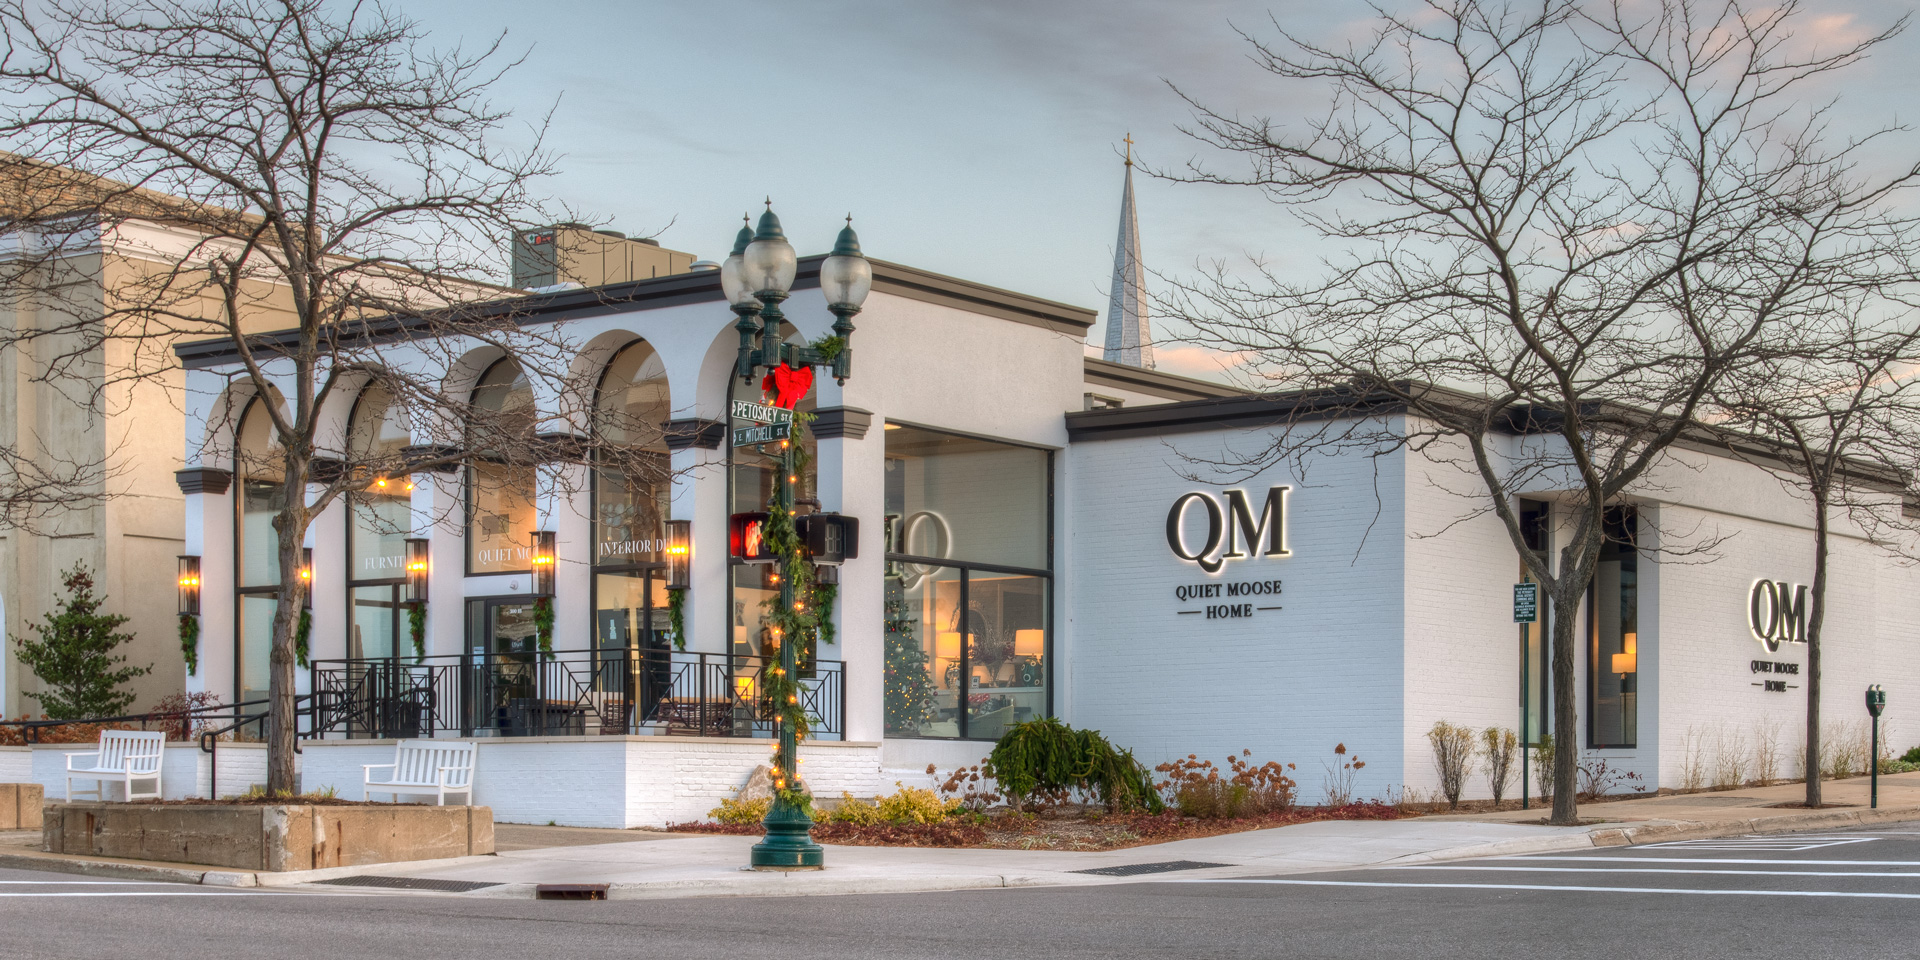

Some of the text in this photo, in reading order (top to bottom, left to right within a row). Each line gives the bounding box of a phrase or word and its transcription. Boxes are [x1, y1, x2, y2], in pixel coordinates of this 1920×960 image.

[737, 402, 778, 422] PETOSKEY
[745, 426, 773, 443] MITCHELL
[1166, 486, 1290, 573] QM
[478, 548, 513, 565] QUIET
[600, 540, 651, 556] INTERIOR
[365, 555, 406, 570] FURNIT
[1175, 580, 1282, 601] QUIET MOOSE
[1206, 603, 1253, 619] HOME
[1750, 579, 1808, 652] QM
[1750, 660, 1799, 674] QUIET MOOSE
[1764, 680, 1786, 692] HOME
